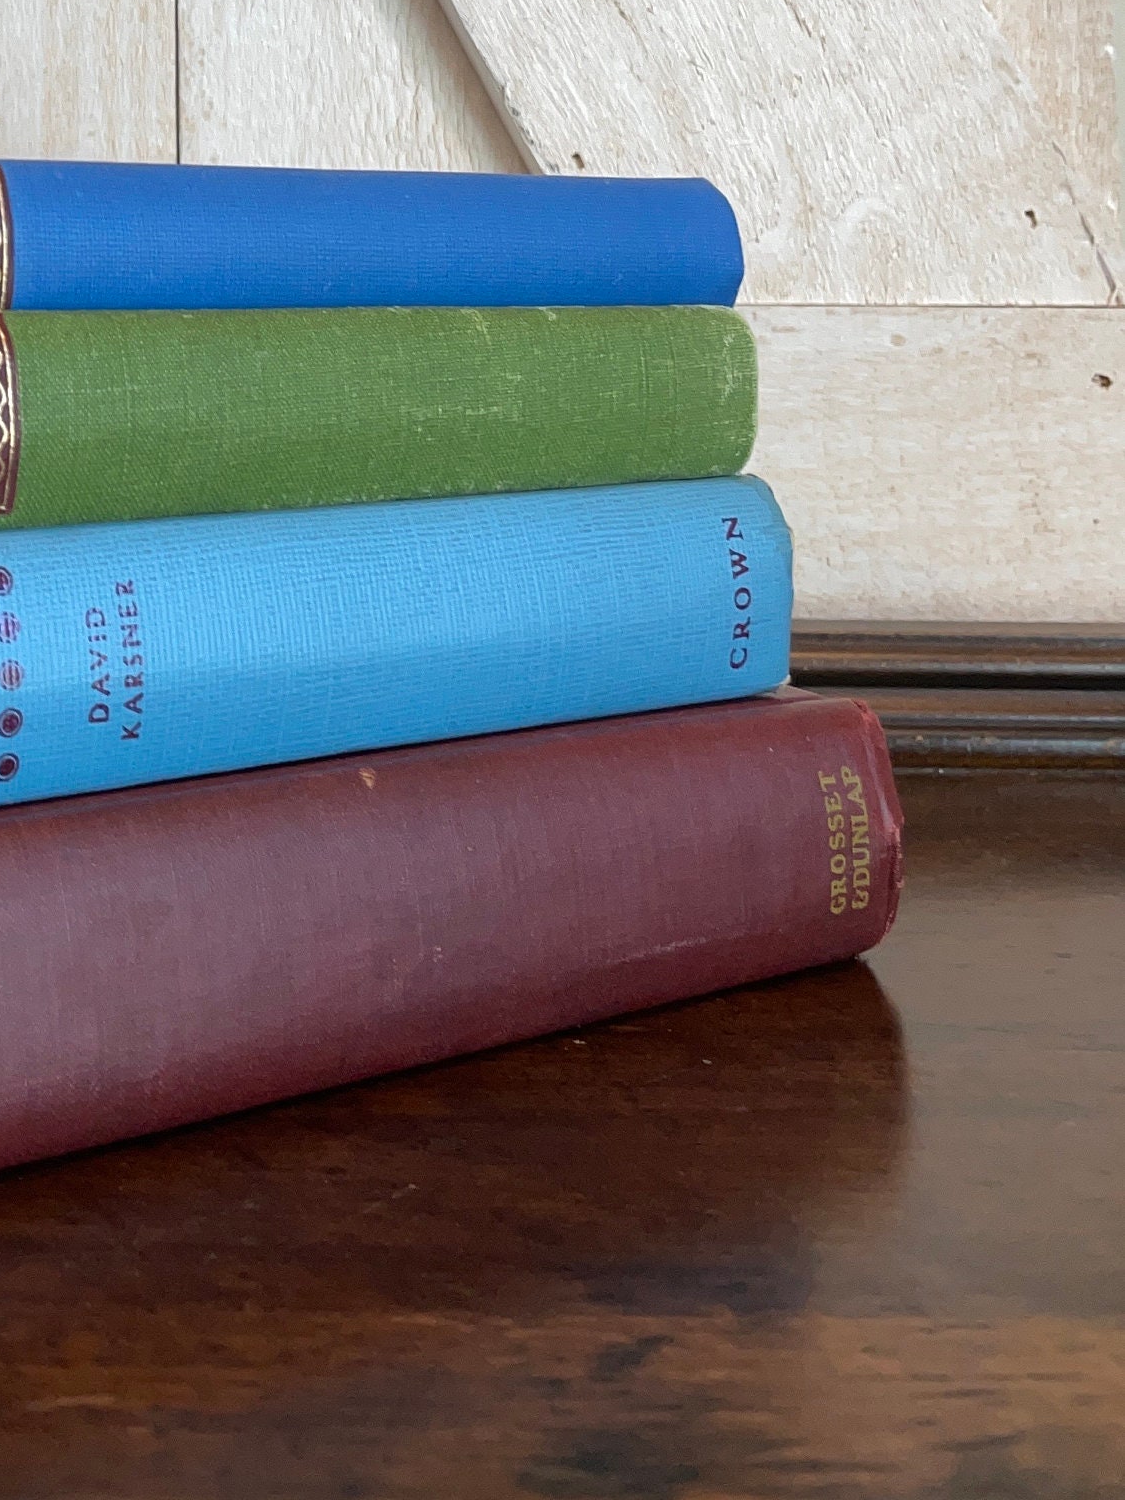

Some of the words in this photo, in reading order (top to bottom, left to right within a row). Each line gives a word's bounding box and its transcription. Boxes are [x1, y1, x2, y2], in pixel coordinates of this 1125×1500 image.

[84, 607, 111, 724] DAVID
[115, 579, 144, 741] KARSNER
[721, 516, 752, 670] CROWN
[818, 769, 847, 915] GROSSET
